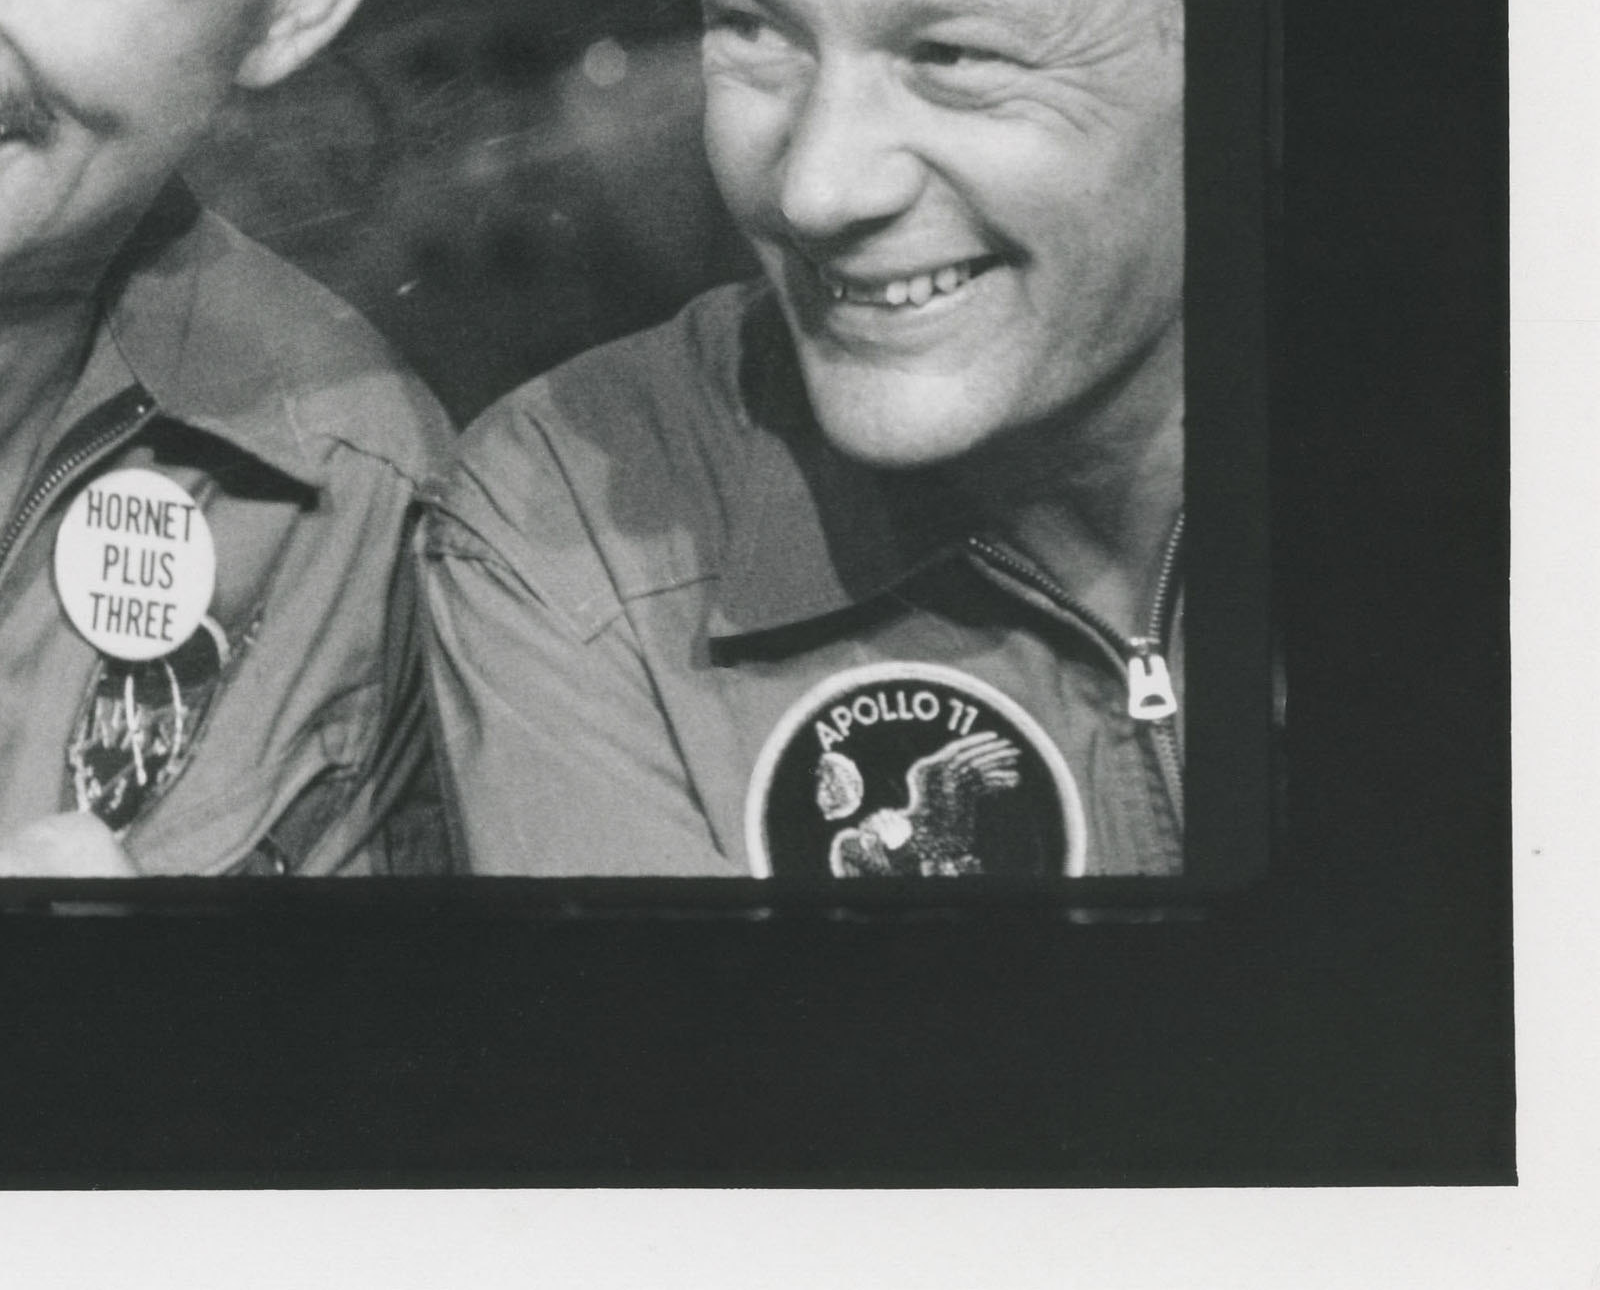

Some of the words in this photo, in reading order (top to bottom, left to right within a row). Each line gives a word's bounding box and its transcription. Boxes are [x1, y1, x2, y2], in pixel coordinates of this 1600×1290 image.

[86, 489, 196, 542] HORNET
[101, 543, 176, 590] PLUS
[88, 591, 177, 642] THREE
[814, 690, 940, 752] APOLLO
[947, 698, 979, 736] 11
